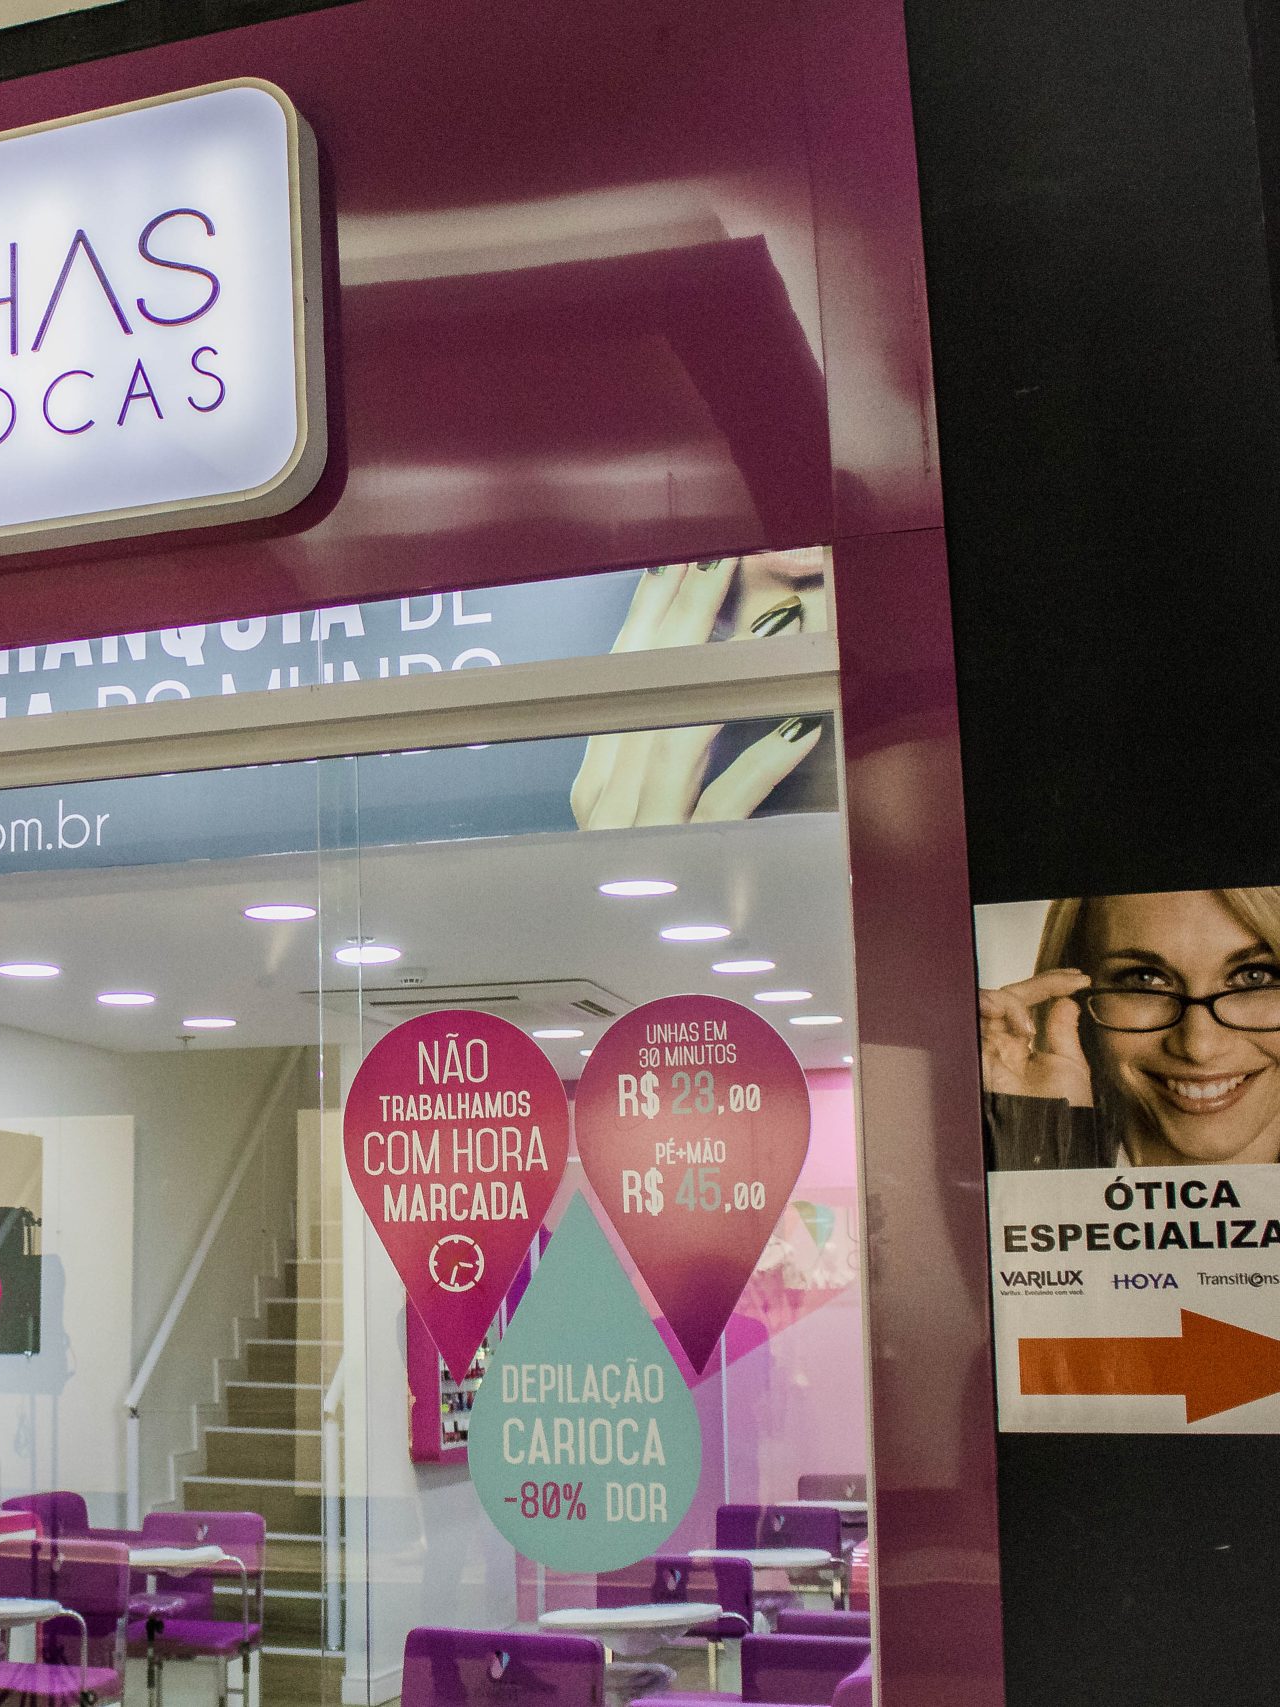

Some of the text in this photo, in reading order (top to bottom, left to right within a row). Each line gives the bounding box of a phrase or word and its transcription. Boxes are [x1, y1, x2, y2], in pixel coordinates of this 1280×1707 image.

[646, 1020, 728, 1045] UNHAS EM
[418, 1032, 489, 1085] NÃO
[638, 1043, 737, 1068] 30 MINUTOS
[379, 1090, 531, 1122] TRABALHAMOS
[618, 1070, 761, 1120] R$ 23,00
[363, 1125, 549, 1176] COM HORA
[655, 1137, 726, 1165] PÉ+MÃO
[384, 1181, 529, 1222] MARCADA
[622, 1167, 766, 1217] R$ 45,00
[1104, 1176, 1241, 1211] ÓTICA
[1003, 1219, 1280, 1253] ESPECIALIZA
[1000, 1270, 1084, 1289] VARILUX
[1111, 1273, 1179, 1290] HOYA
[1196, 1272, 1280, 1288] Transitions
[501, 1358, 664, 1409] DEPILAÇÃO
[502, 1417, 667, 1466] CARIOCA
[504, 1481, 668, 1523] -80% DOR
